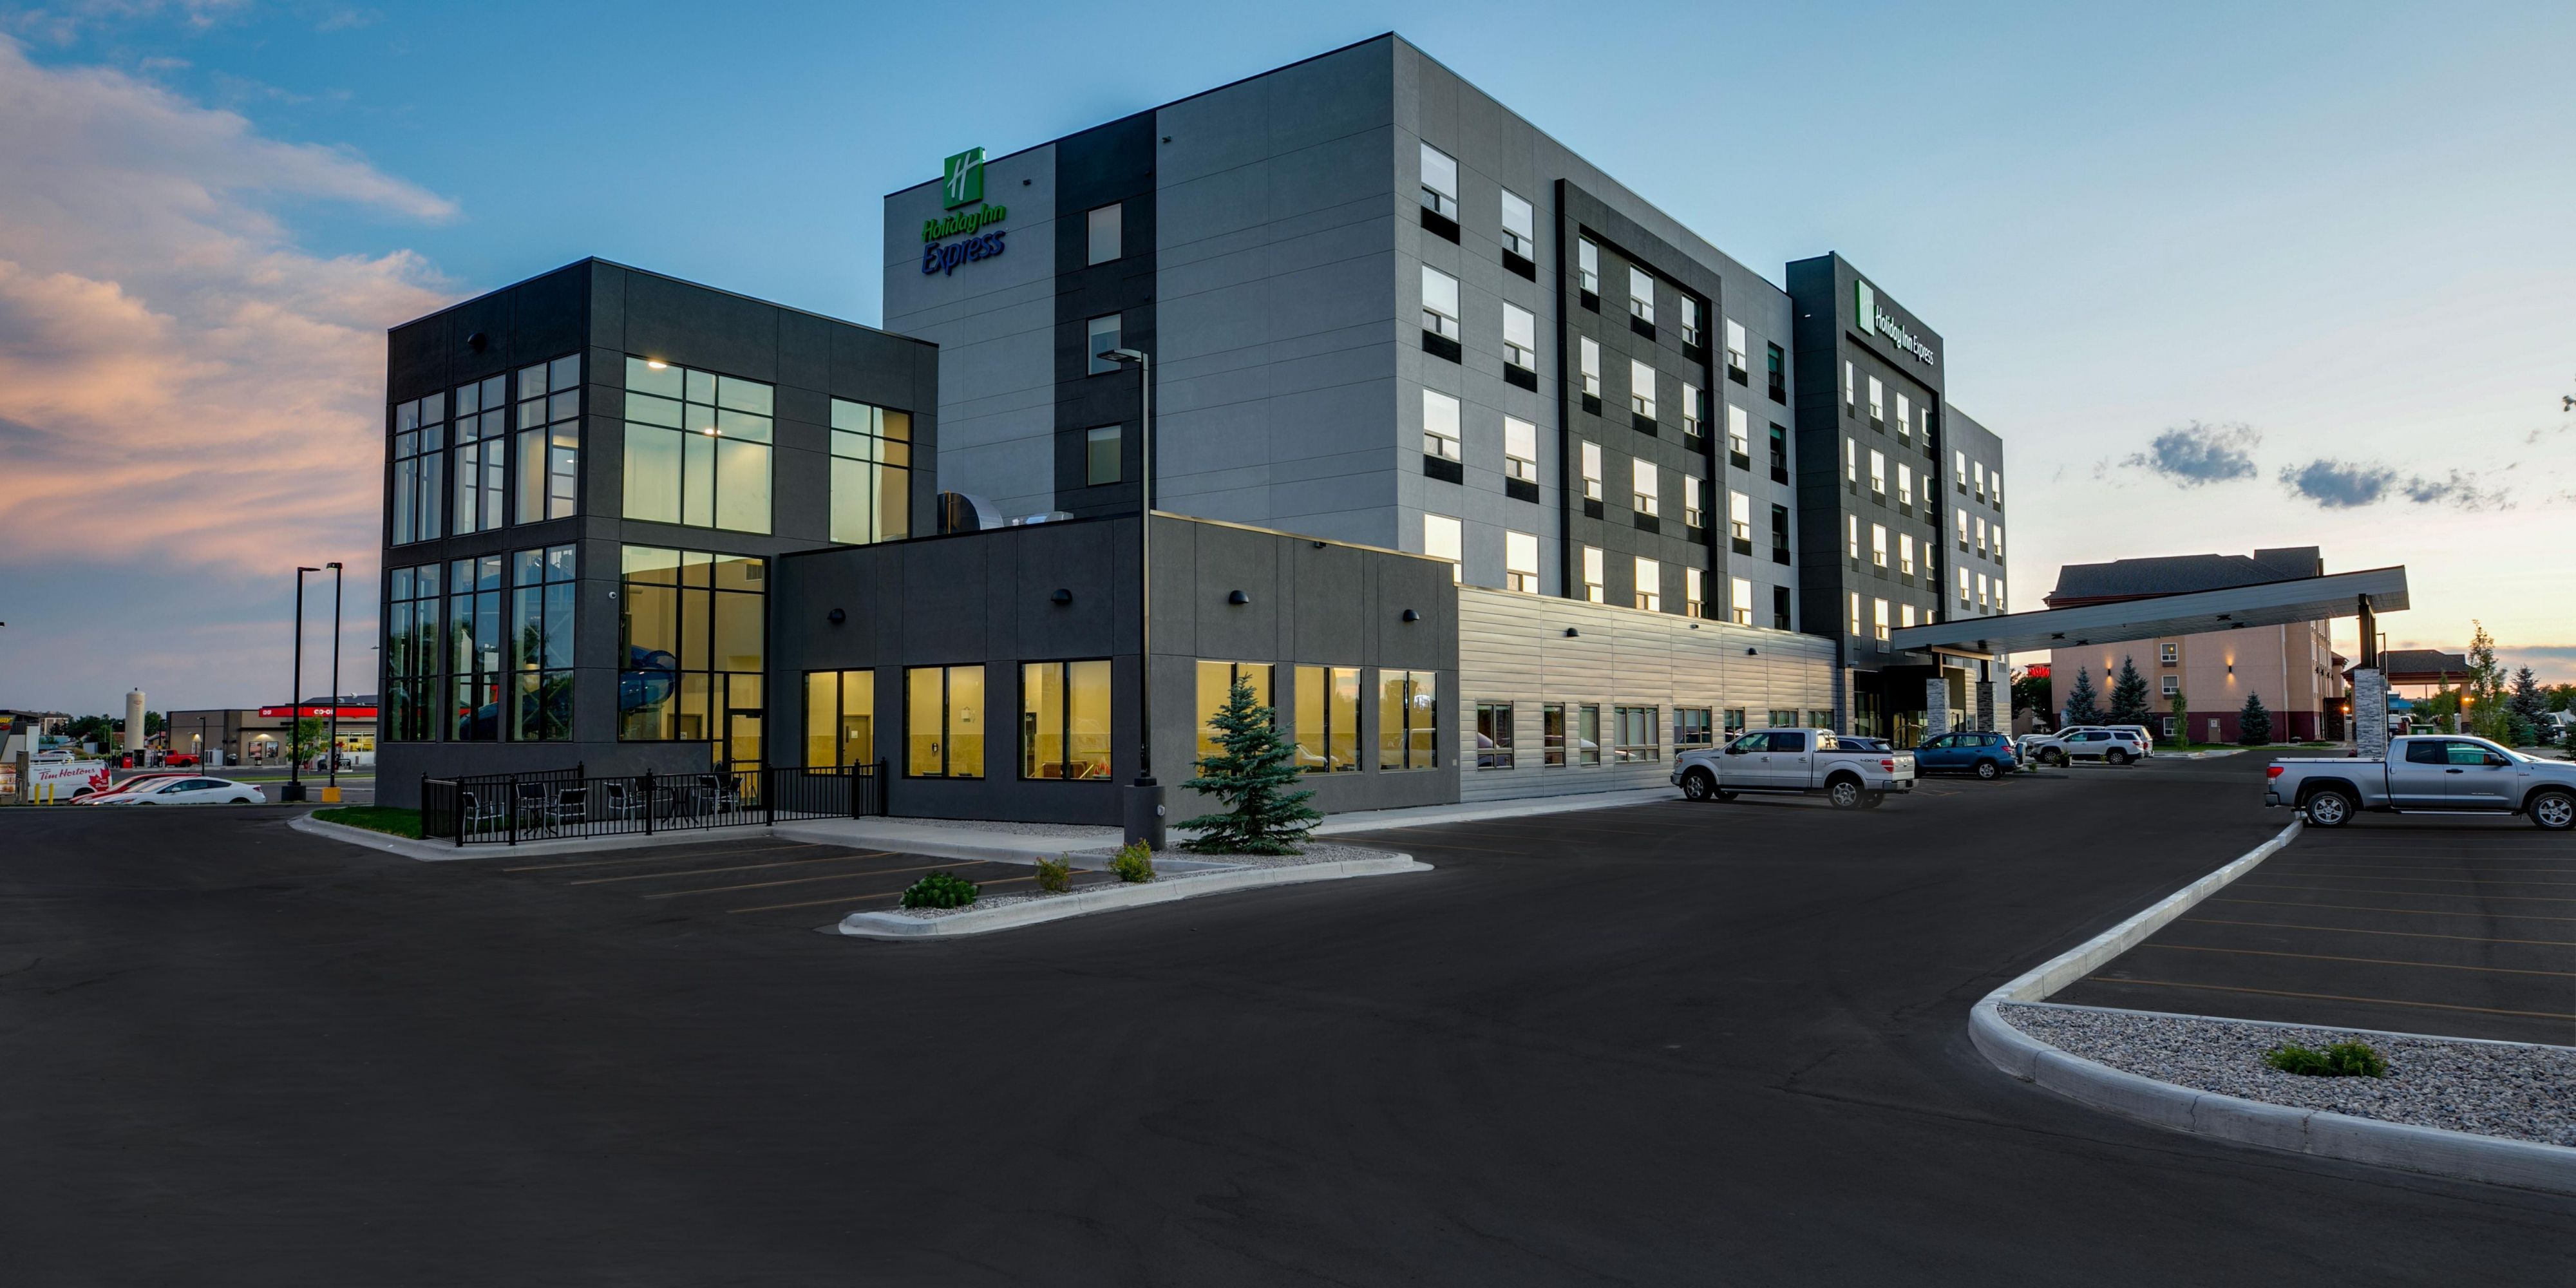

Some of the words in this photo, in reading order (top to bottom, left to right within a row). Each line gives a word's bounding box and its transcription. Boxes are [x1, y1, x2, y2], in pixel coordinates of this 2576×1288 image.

[922, 211, 980, 242] Holiday
[980, 203, 1006, 225] Inn
[922, 231, 1006, 275] Express
[1875, 305, 1902, 348] Holiday
[1902, 325, 1913, 352] Inn
[1913, 335, 1933, 365] Express
[39, 770, 57, 780] Tim
[59, 768, 95, 777] Hortons
